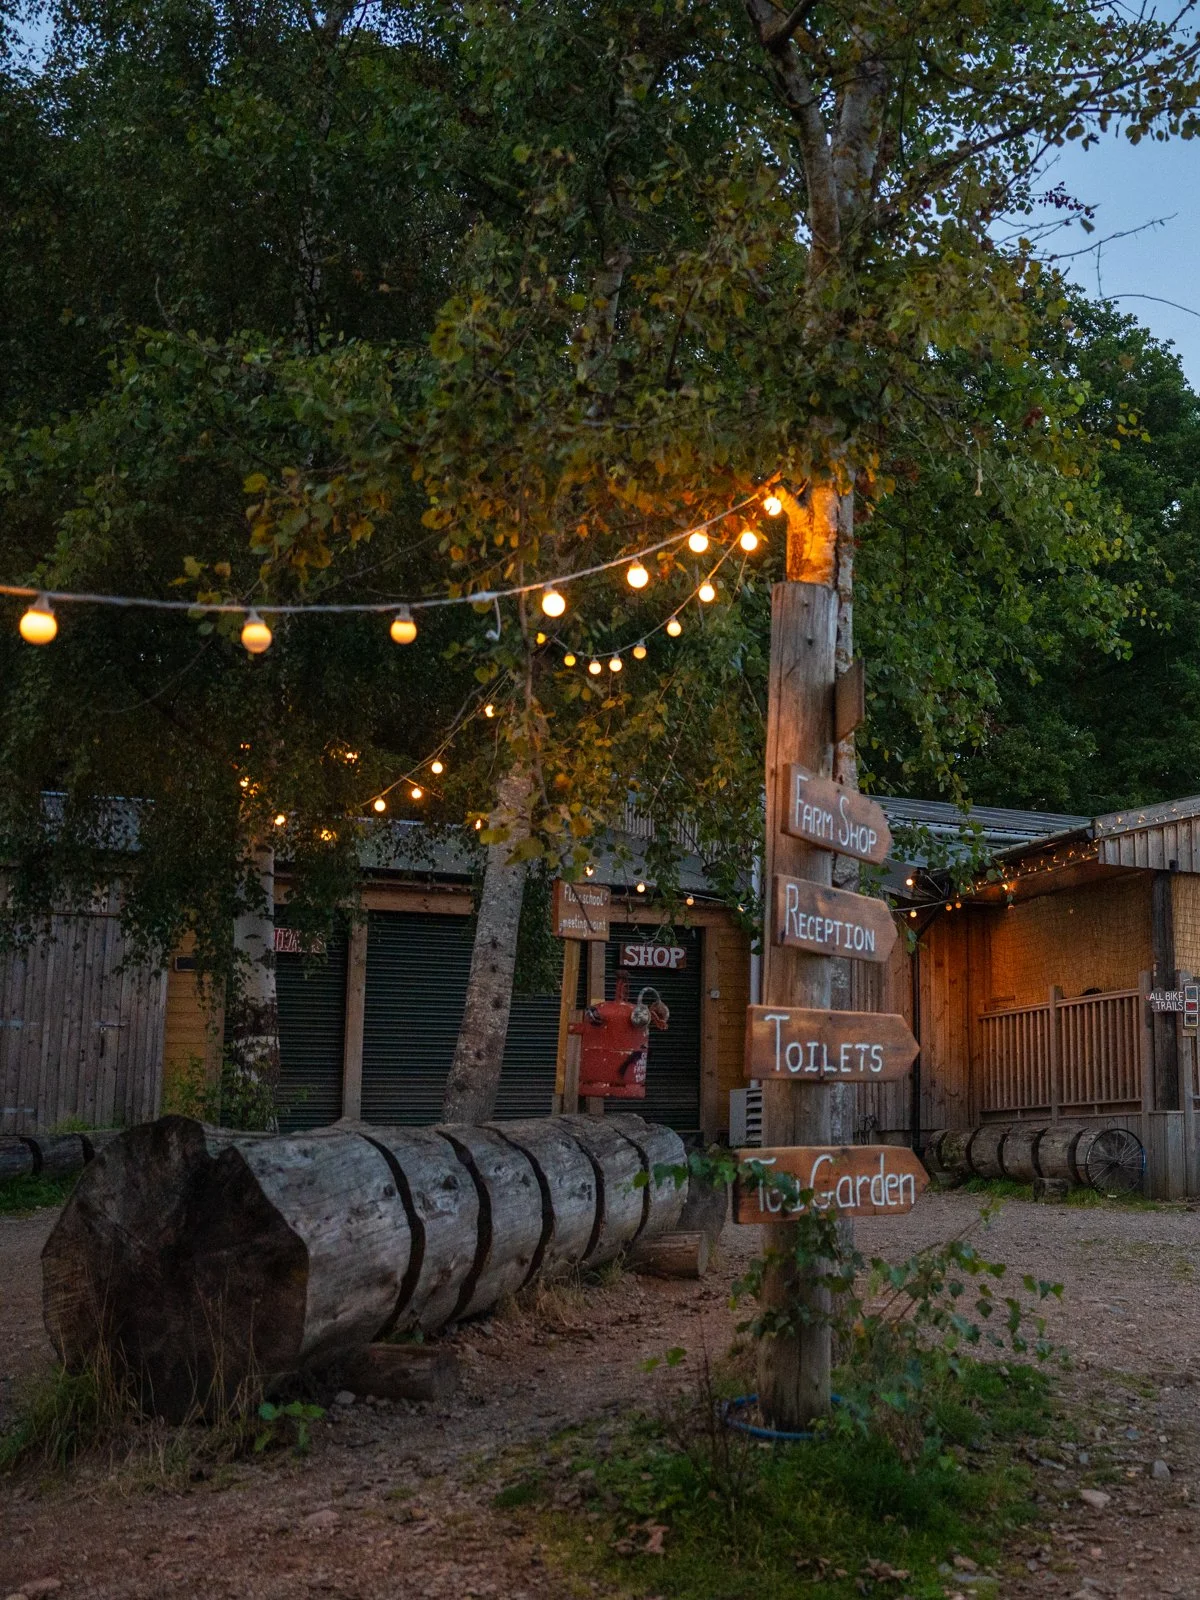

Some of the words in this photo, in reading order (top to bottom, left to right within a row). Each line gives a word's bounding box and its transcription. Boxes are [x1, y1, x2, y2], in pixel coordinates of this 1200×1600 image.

[794, 774, 834, 842] FARM
[839, 795, 879, 856] SHOP
[583, 890, 604, 906] school
[563, 914, 587, 937] meeting
[785, 883, 876, 954] RECEPTION
[623, 945, 686, 968] SHOP
[1149, 991, 1164, 1001] ALL
[1165, 991, 1185, 1001] BIKE
[1155, 1000, 1184, 1012] TRAILS
[764, 1014, 884, 1074] TOILETS
[809, 1152, 915, 1209] Garden
